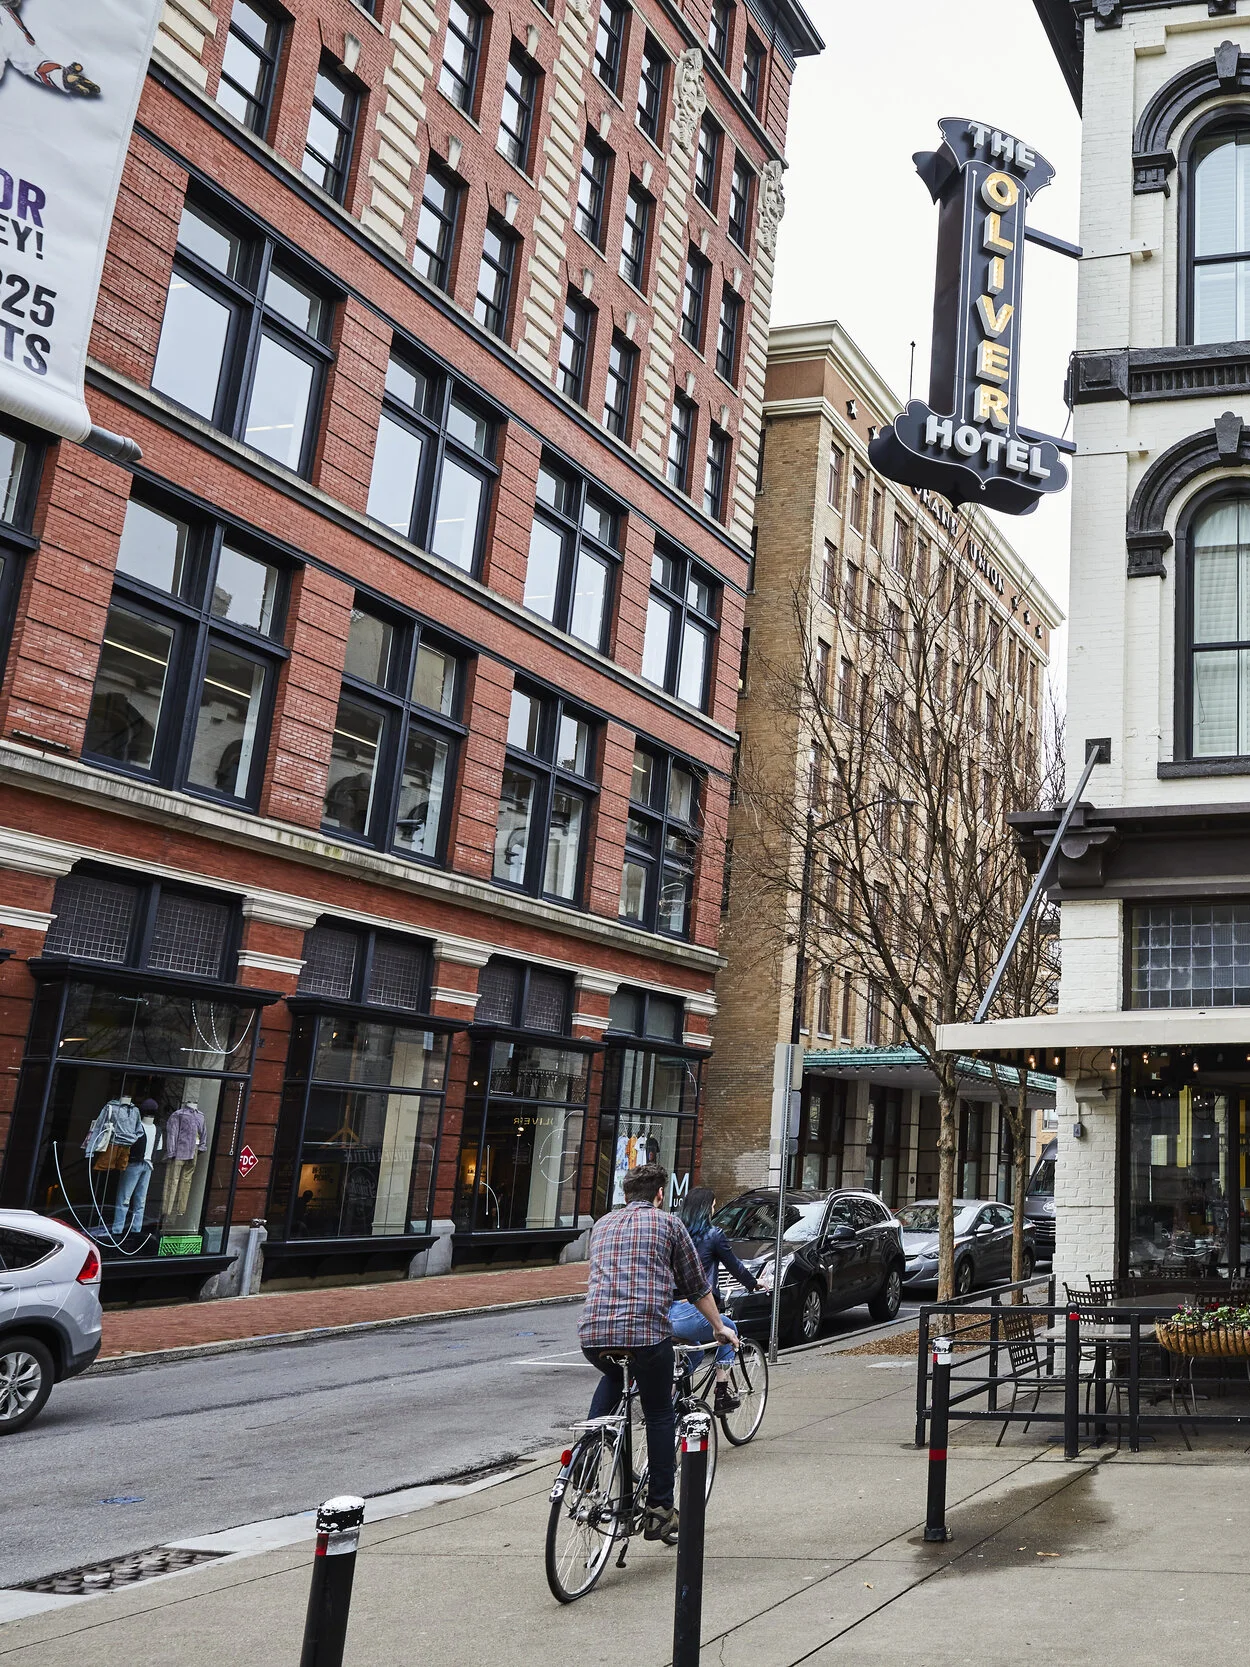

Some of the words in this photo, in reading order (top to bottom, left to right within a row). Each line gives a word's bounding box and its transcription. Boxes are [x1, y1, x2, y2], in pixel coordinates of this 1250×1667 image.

[968, 121, 1036, 172] THE
[0, 269, 57, 328] 25
[975, 171, 1020, 430] OLIVER
[926, 414, 1052, 480] HOTEL
